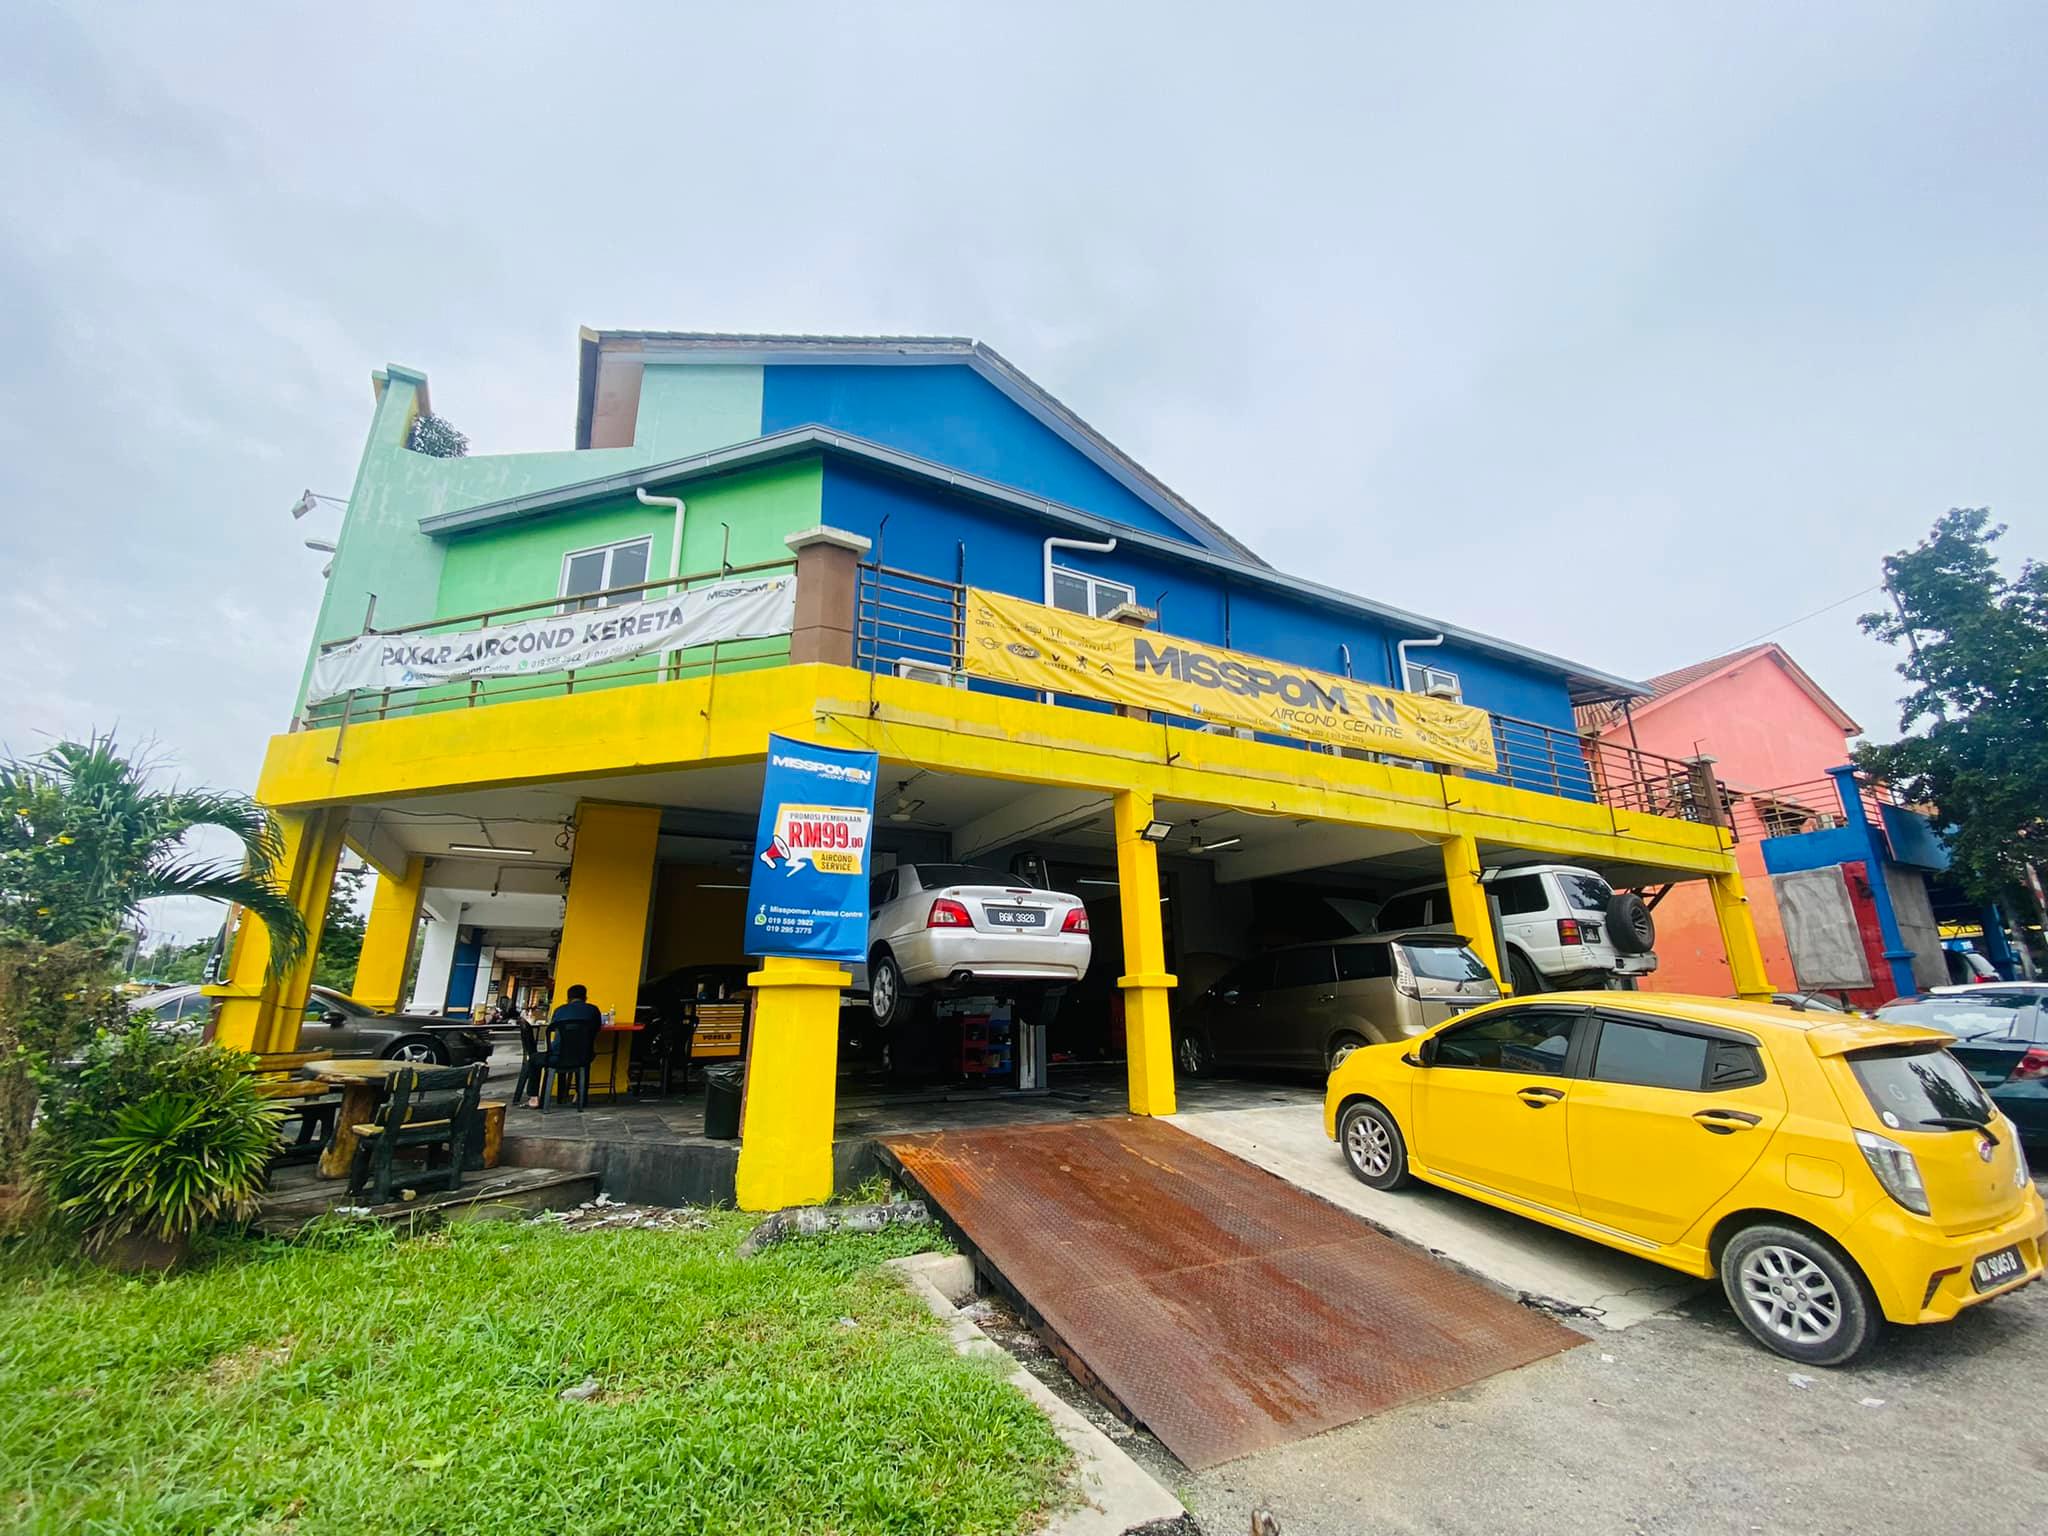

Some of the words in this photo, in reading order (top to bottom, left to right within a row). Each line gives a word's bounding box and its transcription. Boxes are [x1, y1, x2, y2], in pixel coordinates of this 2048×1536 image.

[455, 627, 575, 662] AIRCOND
[582, 606, 684, 644] KERETA
[1134, 637, 1398, 724] MISSPOMN
[1270, 707, 1337, 728] AIRCOND
[1343, 719, 1403, 739] CENTRE
[790, 812, 820, 821] PROMOSI
[822, 814, 862, 823] PEMBUKAAN
[821, 854, 853, 862] AIRCOND
[821, 862, 851, 871] SERVICE
[767, 916, 781, 924] 019
[999, 912, 1014, 922] BGK
[794, 927, 812, 935] 3775
